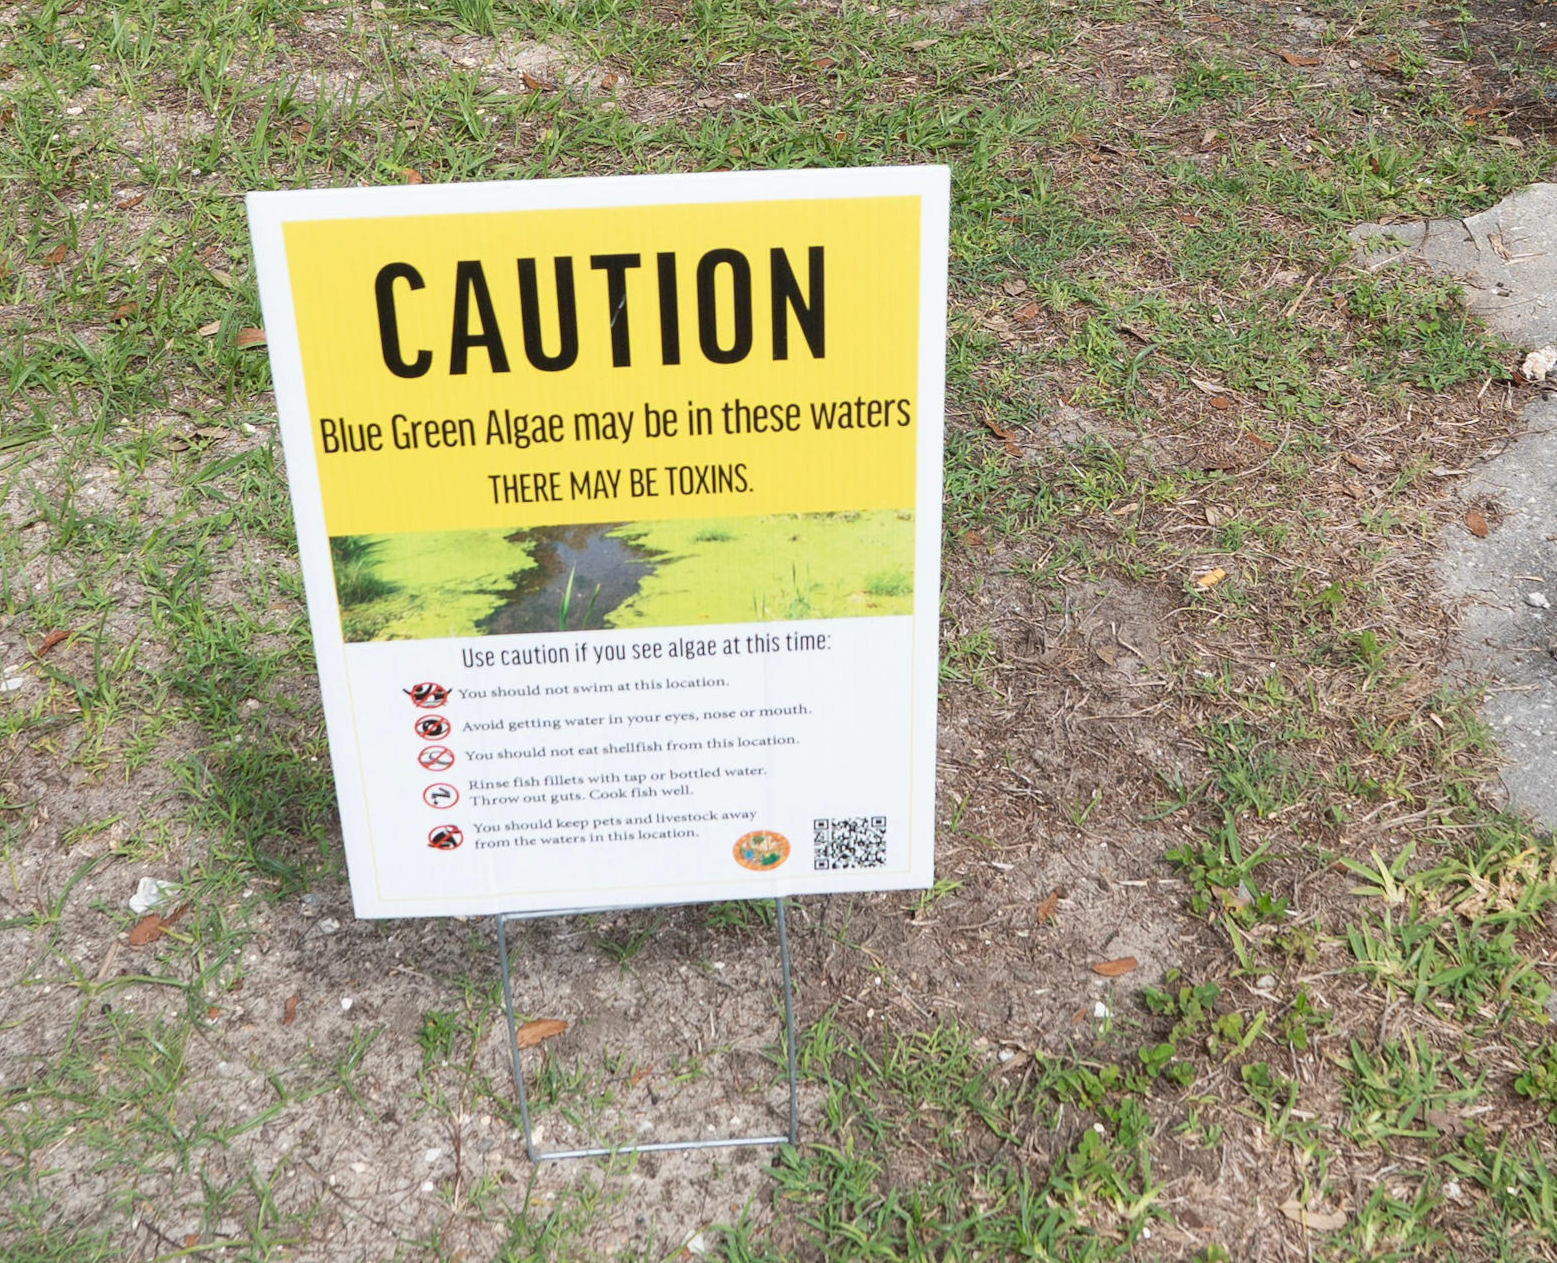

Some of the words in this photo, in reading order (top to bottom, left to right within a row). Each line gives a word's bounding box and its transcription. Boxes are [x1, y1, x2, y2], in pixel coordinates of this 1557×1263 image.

[374, 245, 826, 379] CAUTION
[320, 417, 383, 454] Blue
[391, 414, 476, 450] Green
[486, 409, 564, 449] Algae
[574, 411, 634, 444] may
[644, 402, 678, 438] be
[688, 400, 713, 436] in
[721, 398, 801, 435] these
[810, 396, 911, 430] waters
[487, 472, 563, 504] THERE
[570, 469, 621, 500] MAY
[630, 467, 659, 498] BE
[664, 463, 754, 496] TOXINS.
[462, 648, 495, 668] Use
[501, 644, 569, 666] caution
[575, 642, 587, 663] if
[593, 644, 626, 665] you
[632, 642, 662, 660] see
[668, 637, 717, 660] algae
[722, 637, 741, 655] at
[746, 633, 780, 654] this
[785, 631, 831, 652] time:
[458, 689, 487, 700] You
[491, 684, 541, 698] should
[545, 685, 569, 696] not
[573, 682, 614, 694] swim
[617, 682, 630, 691] at
[634, 679, 663, 691] this
[666, 677, 729, 689] location.
[462, 718, 504, 732] Avoid
[508, 718, 562, 732] getting
[564, 717, 605, 727] water
[609, 714, 623, 725] in
[627, 714, 661, 727] your
[664, 713, 699, 724] eyes,
[703, 710, 736, 720] nose
[739, 709, 756, 718] or
[759, 703, 812, 717] mouth.
[465, 751, 494, 761] You
[497, 746, 547, 759] should
[550, 747, 574, 757] not
[578, 746, 598, 756] eat
[602, 741, 663, 754] shellfish
[666, 740, 703, 751] from
[707, 738, 734, 749] this
[737, 735, 800, 747] location.
[469, 779, 510, 791] Rinse
[513, 776, 540, 788] fish
[544, 775, 585, 786] fillets
[587, 772, 620, 784] with
[624, 773, 647, 785] tap
[650, 773, 666, 781] or
[669, 767, 721, 780] bottled
[724, 767, 767, 777] water.
[469, 795, 520, 806] Throw
[523, 794, 547, 803] out
[550, 792, 585, 805] guts.
[589, 787, 628, 800] Cook
[631, 786, 658, 798] fish
[661, 784, 693, 796] well.
[473, 823, 501, 834] You
[504, 818, 553, 831] should
[556, 818, 589, 831] keep
[593, 817, 622, 830] pets
[625, 813, 653, 825] and
[656, 810, 718, 824] livestock
[721, 811, 757, 822] away
[475, 839, 510, 850] from
[514, 835, 537, 847] the
[540, 835, 586, 845] waters
[589, 833, 604, 842] in
[608, 831, 635, 842] this
[638, 828, 699, 840] location.
